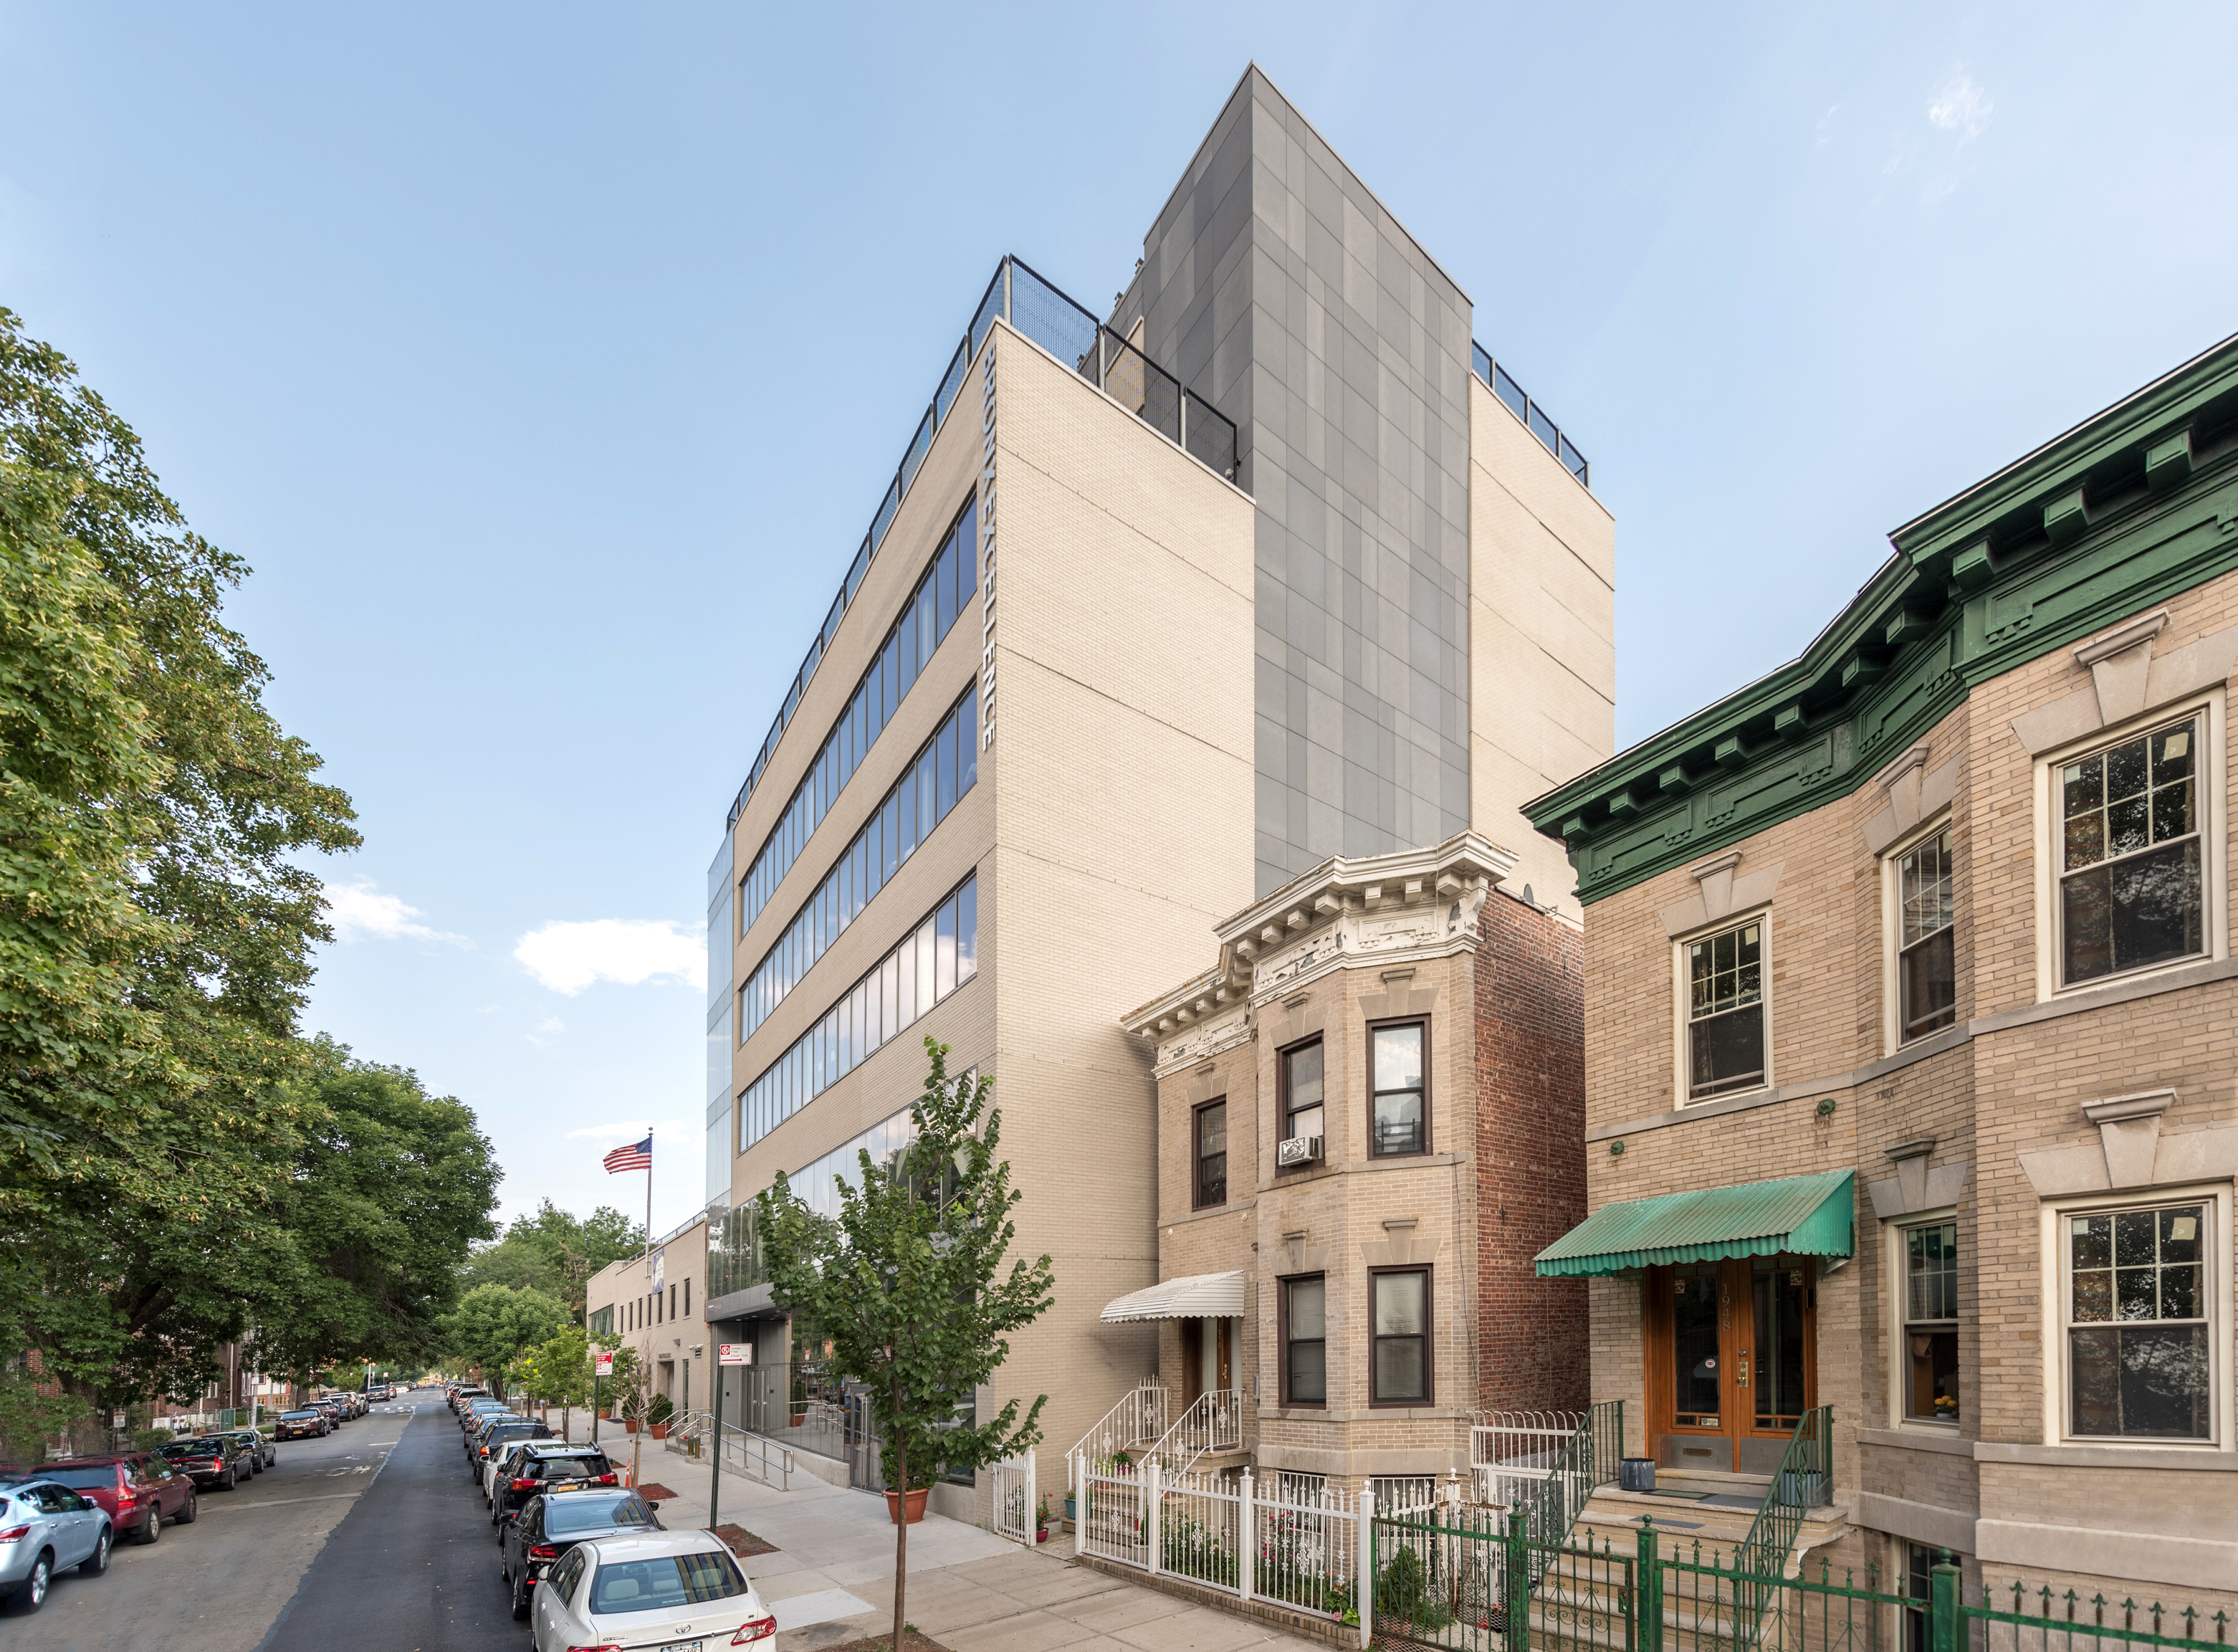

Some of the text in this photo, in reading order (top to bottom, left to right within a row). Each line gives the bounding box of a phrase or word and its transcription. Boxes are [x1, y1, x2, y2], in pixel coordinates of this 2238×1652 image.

[982, 338, 995, 752] BRONX EXCELLENCE
[1722, 1283, 1731, 1332] 1948
